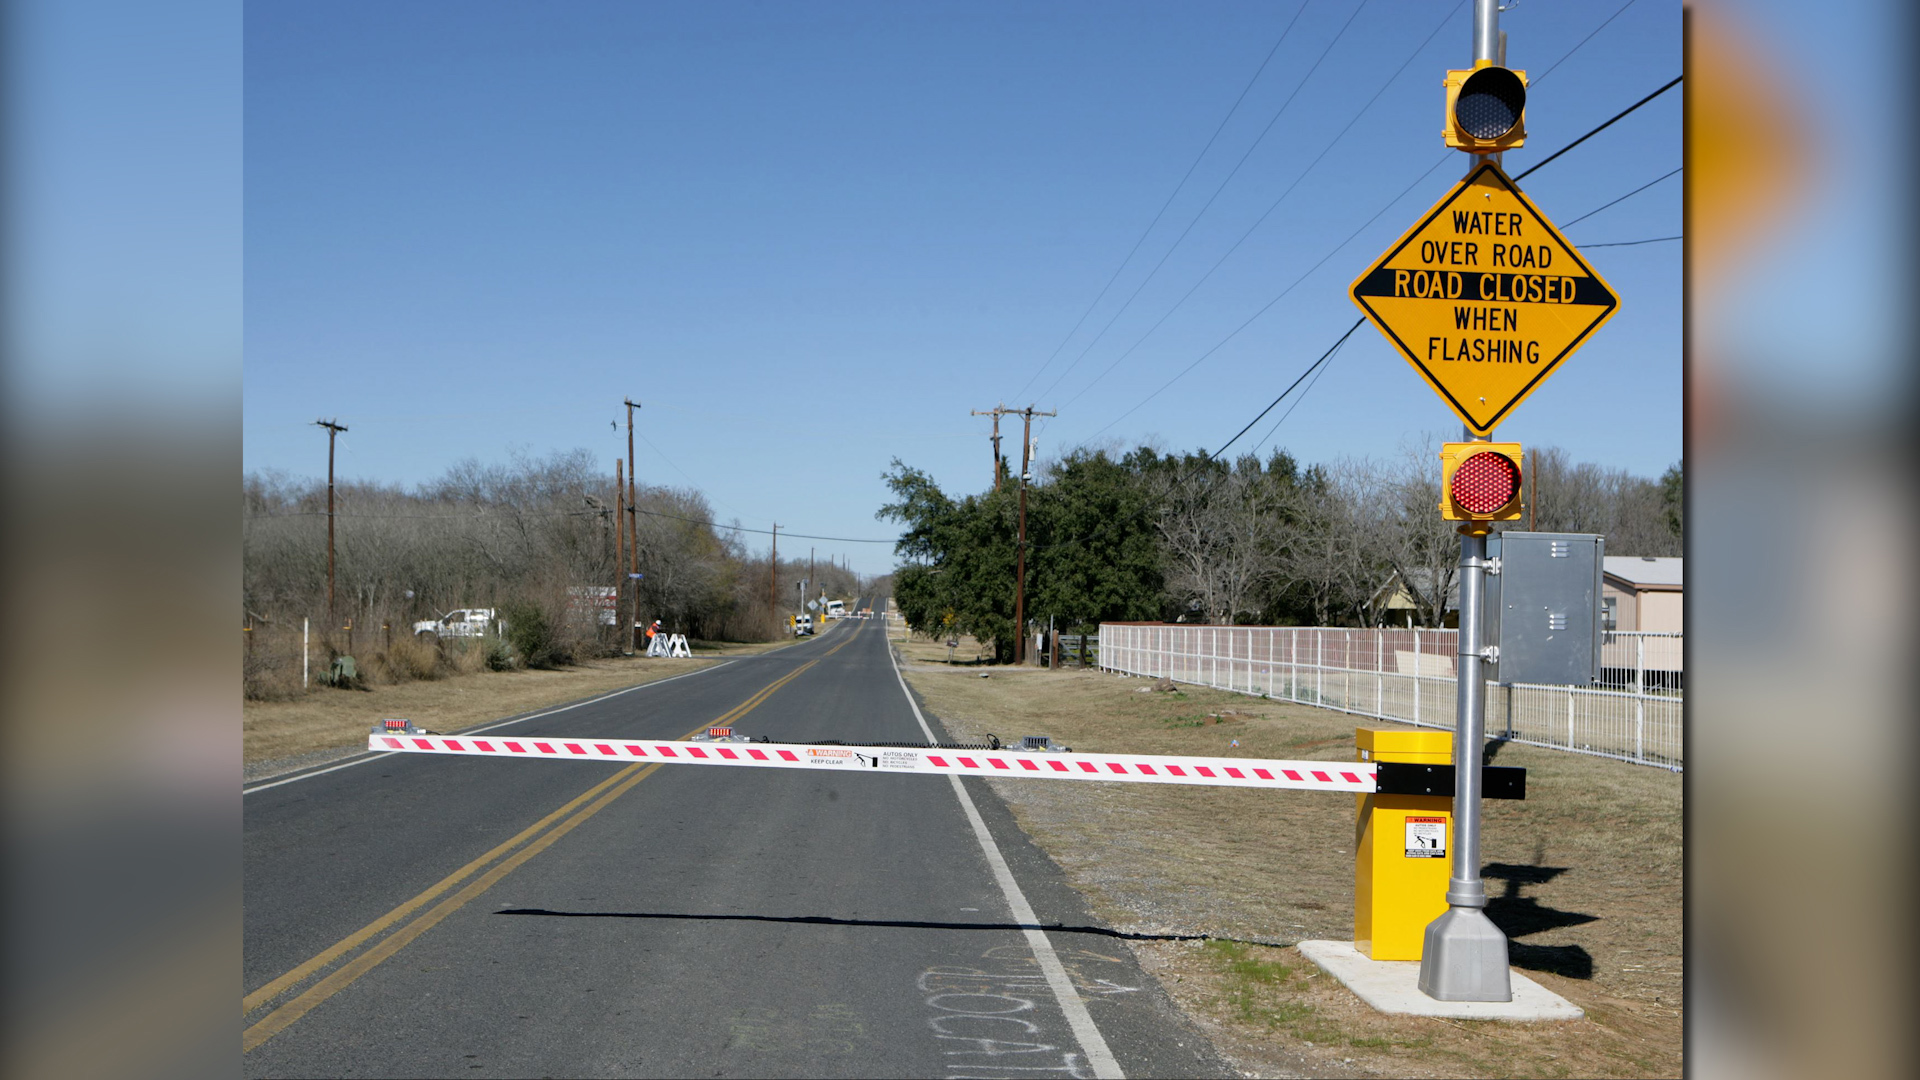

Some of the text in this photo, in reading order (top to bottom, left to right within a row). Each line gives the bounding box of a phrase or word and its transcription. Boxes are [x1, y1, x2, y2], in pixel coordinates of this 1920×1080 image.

[1452, 210, 1522, 236] WATER
[1421, 240, 1552, 269] OVER ROAD
[1394, 269, 1577, 304] ROAD CLOSED
[1454, 306, 1517, 332] WHEN
[1428, 337, 1540, 364] FLASHING
[816, 749, 852, 757] WARNING
